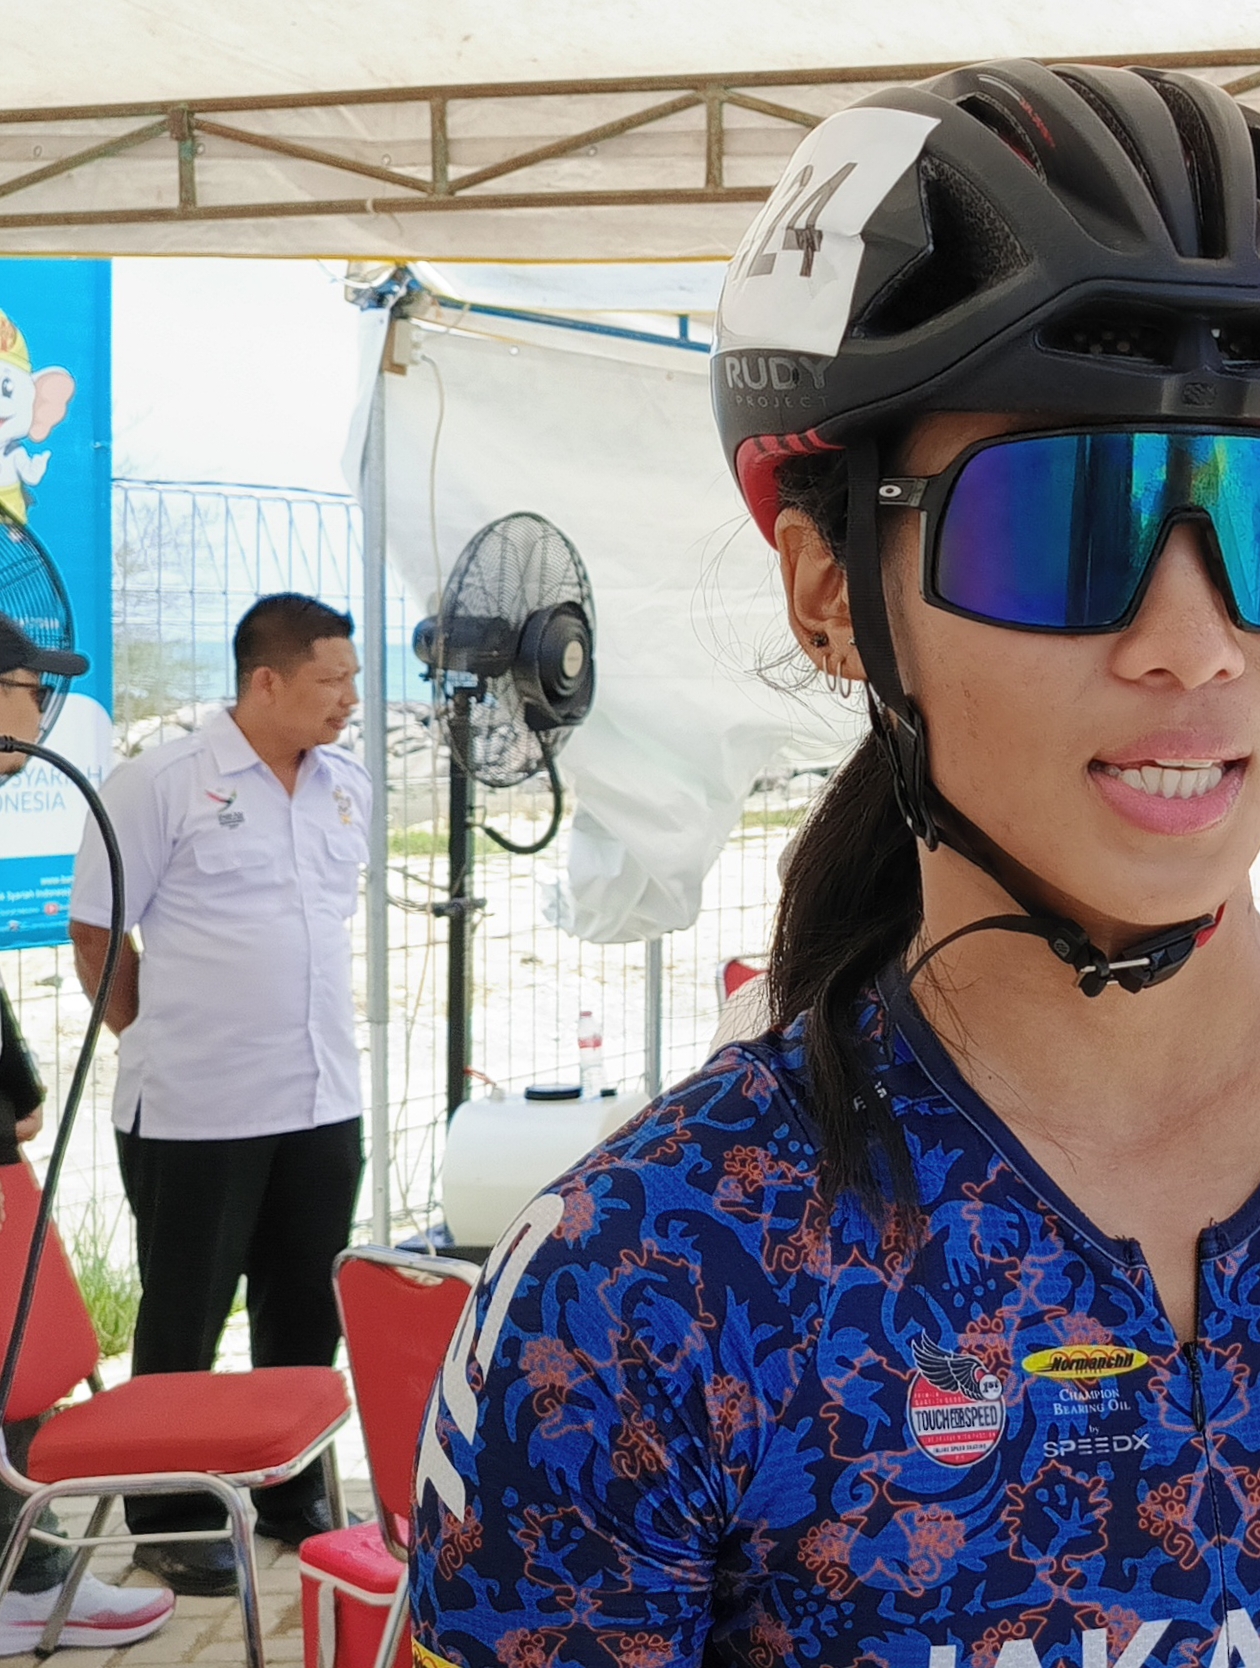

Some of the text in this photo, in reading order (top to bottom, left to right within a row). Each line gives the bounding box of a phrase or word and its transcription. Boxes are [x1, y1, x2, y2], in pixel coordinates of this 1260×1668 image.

[725, 356, 834, 390] RUDY
[735, 395, 830, 408] PROJECT
[1059, 1388, 1120, 1402] CHAMPION
[1053, 1399, 1131, 1416] BEARING OIL
[1043, 1433, 1151, 1458] SPEEDX
